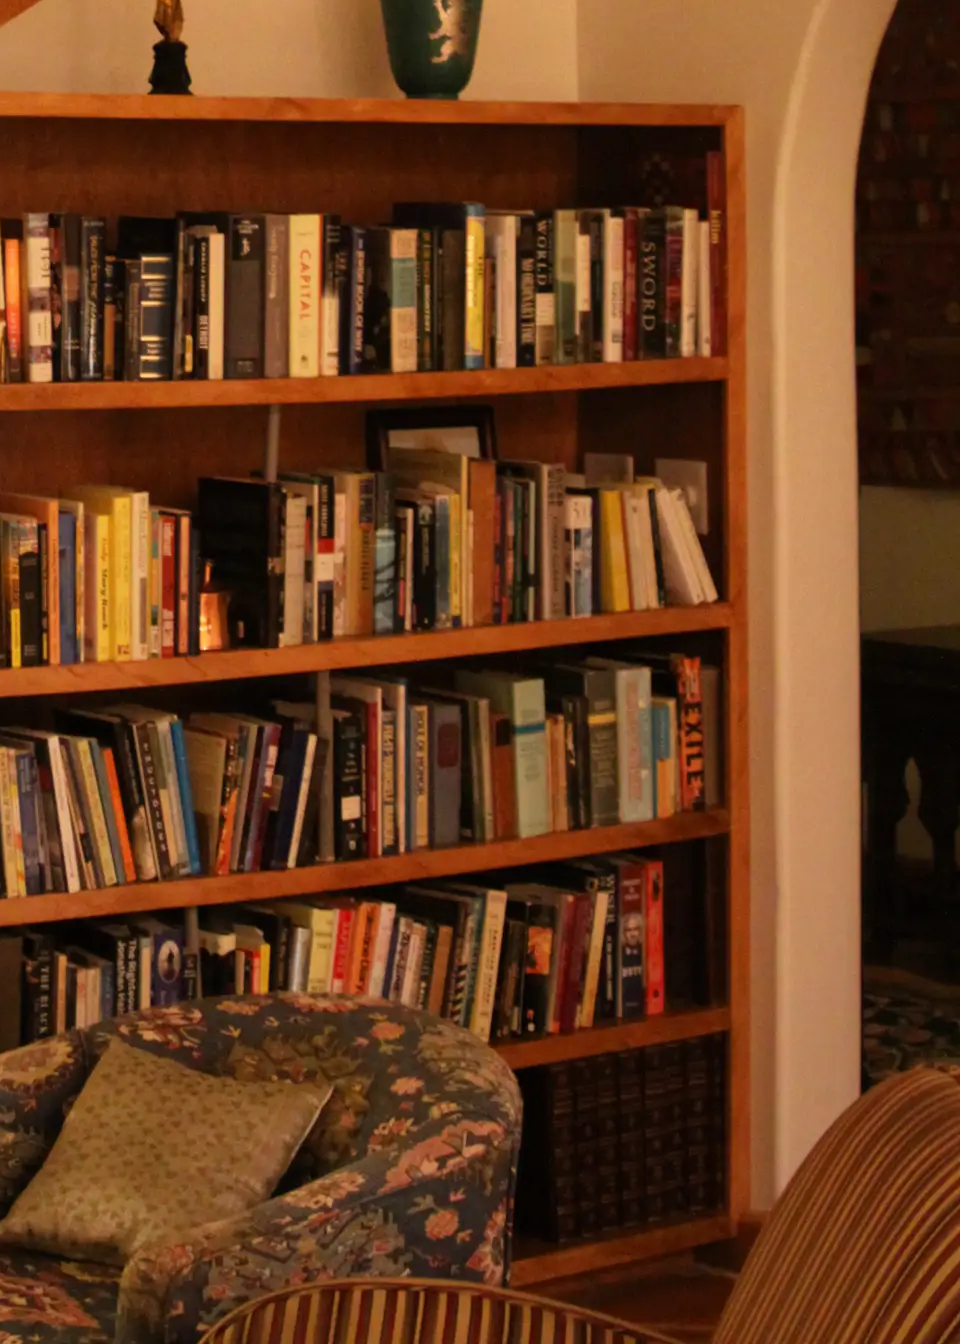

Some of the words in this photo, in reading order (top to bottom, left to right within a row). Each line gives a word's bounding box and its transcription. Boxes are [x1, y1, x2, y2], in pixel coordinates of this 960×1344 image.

[536, 220, 547, 286] WORLD
[710, 210, 721, 244] kilim
[299, 249, 311, 320] CAPITAL
[640, 241, 655, 330] SWORD
[199, 315, 208, 349] DETROIT
[685, 703, 703, 785] EXILE
[40, 965, 49, 989] THE
